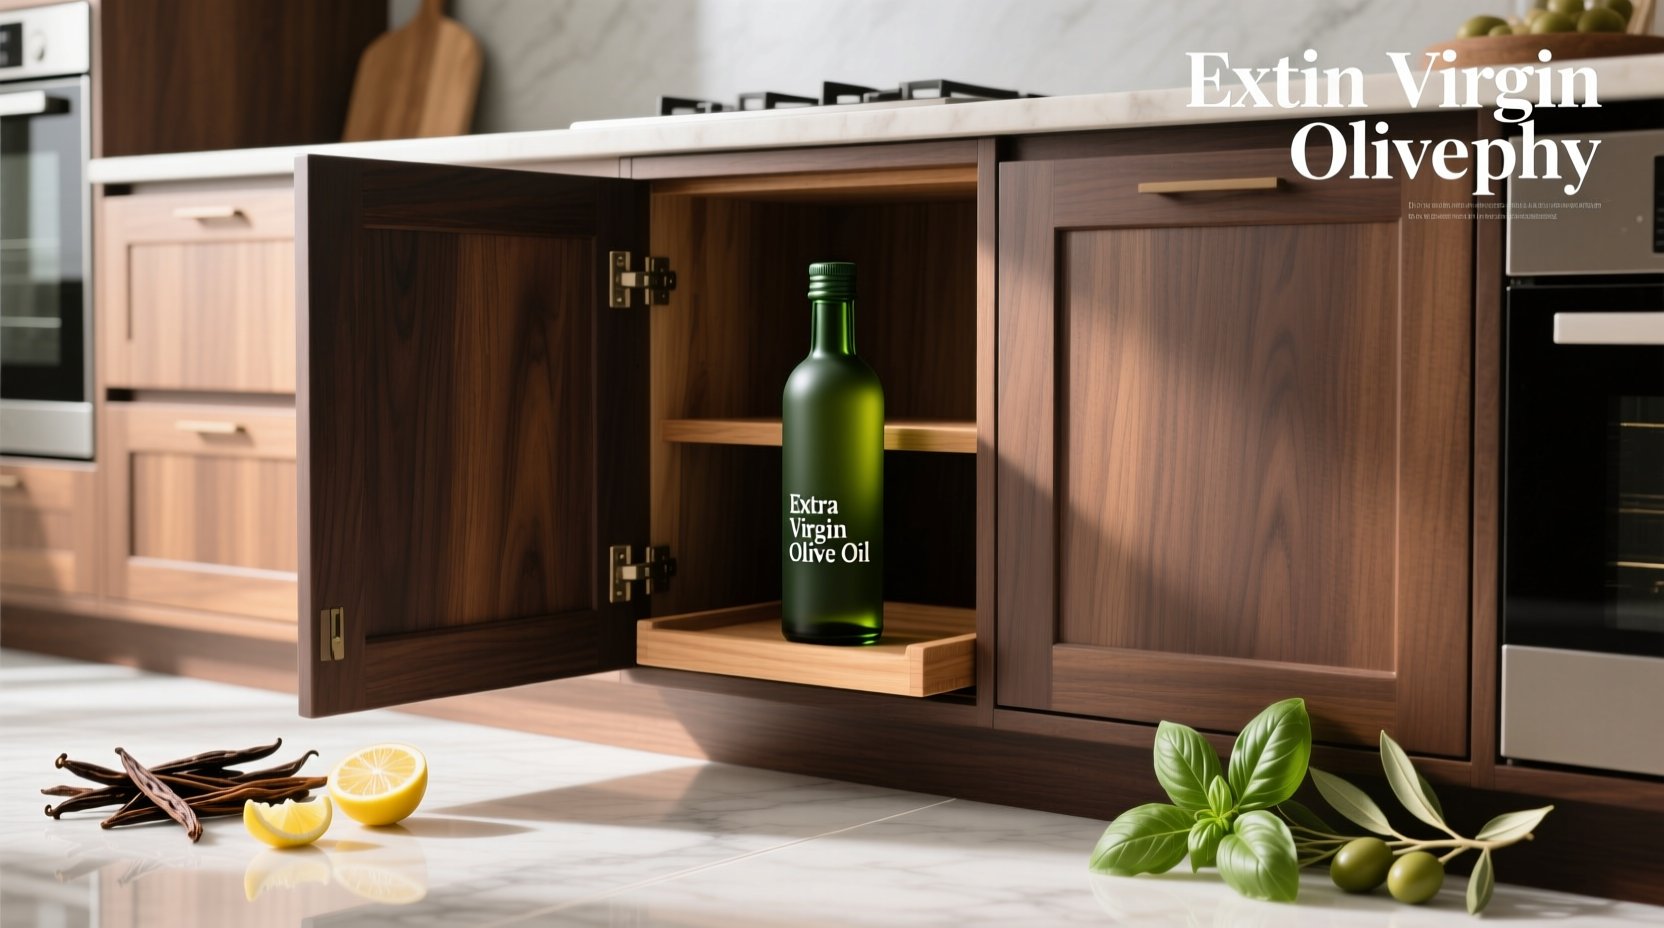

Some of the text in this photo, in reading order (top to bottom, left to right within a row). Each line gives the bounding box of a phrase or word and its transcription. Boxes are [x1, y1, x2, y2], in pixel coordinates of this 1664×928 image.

[789, 493, 839, 515] Extra
[789, 517, 848, 545] Virgin
[789, 541, 871, 564] Olive Oil
